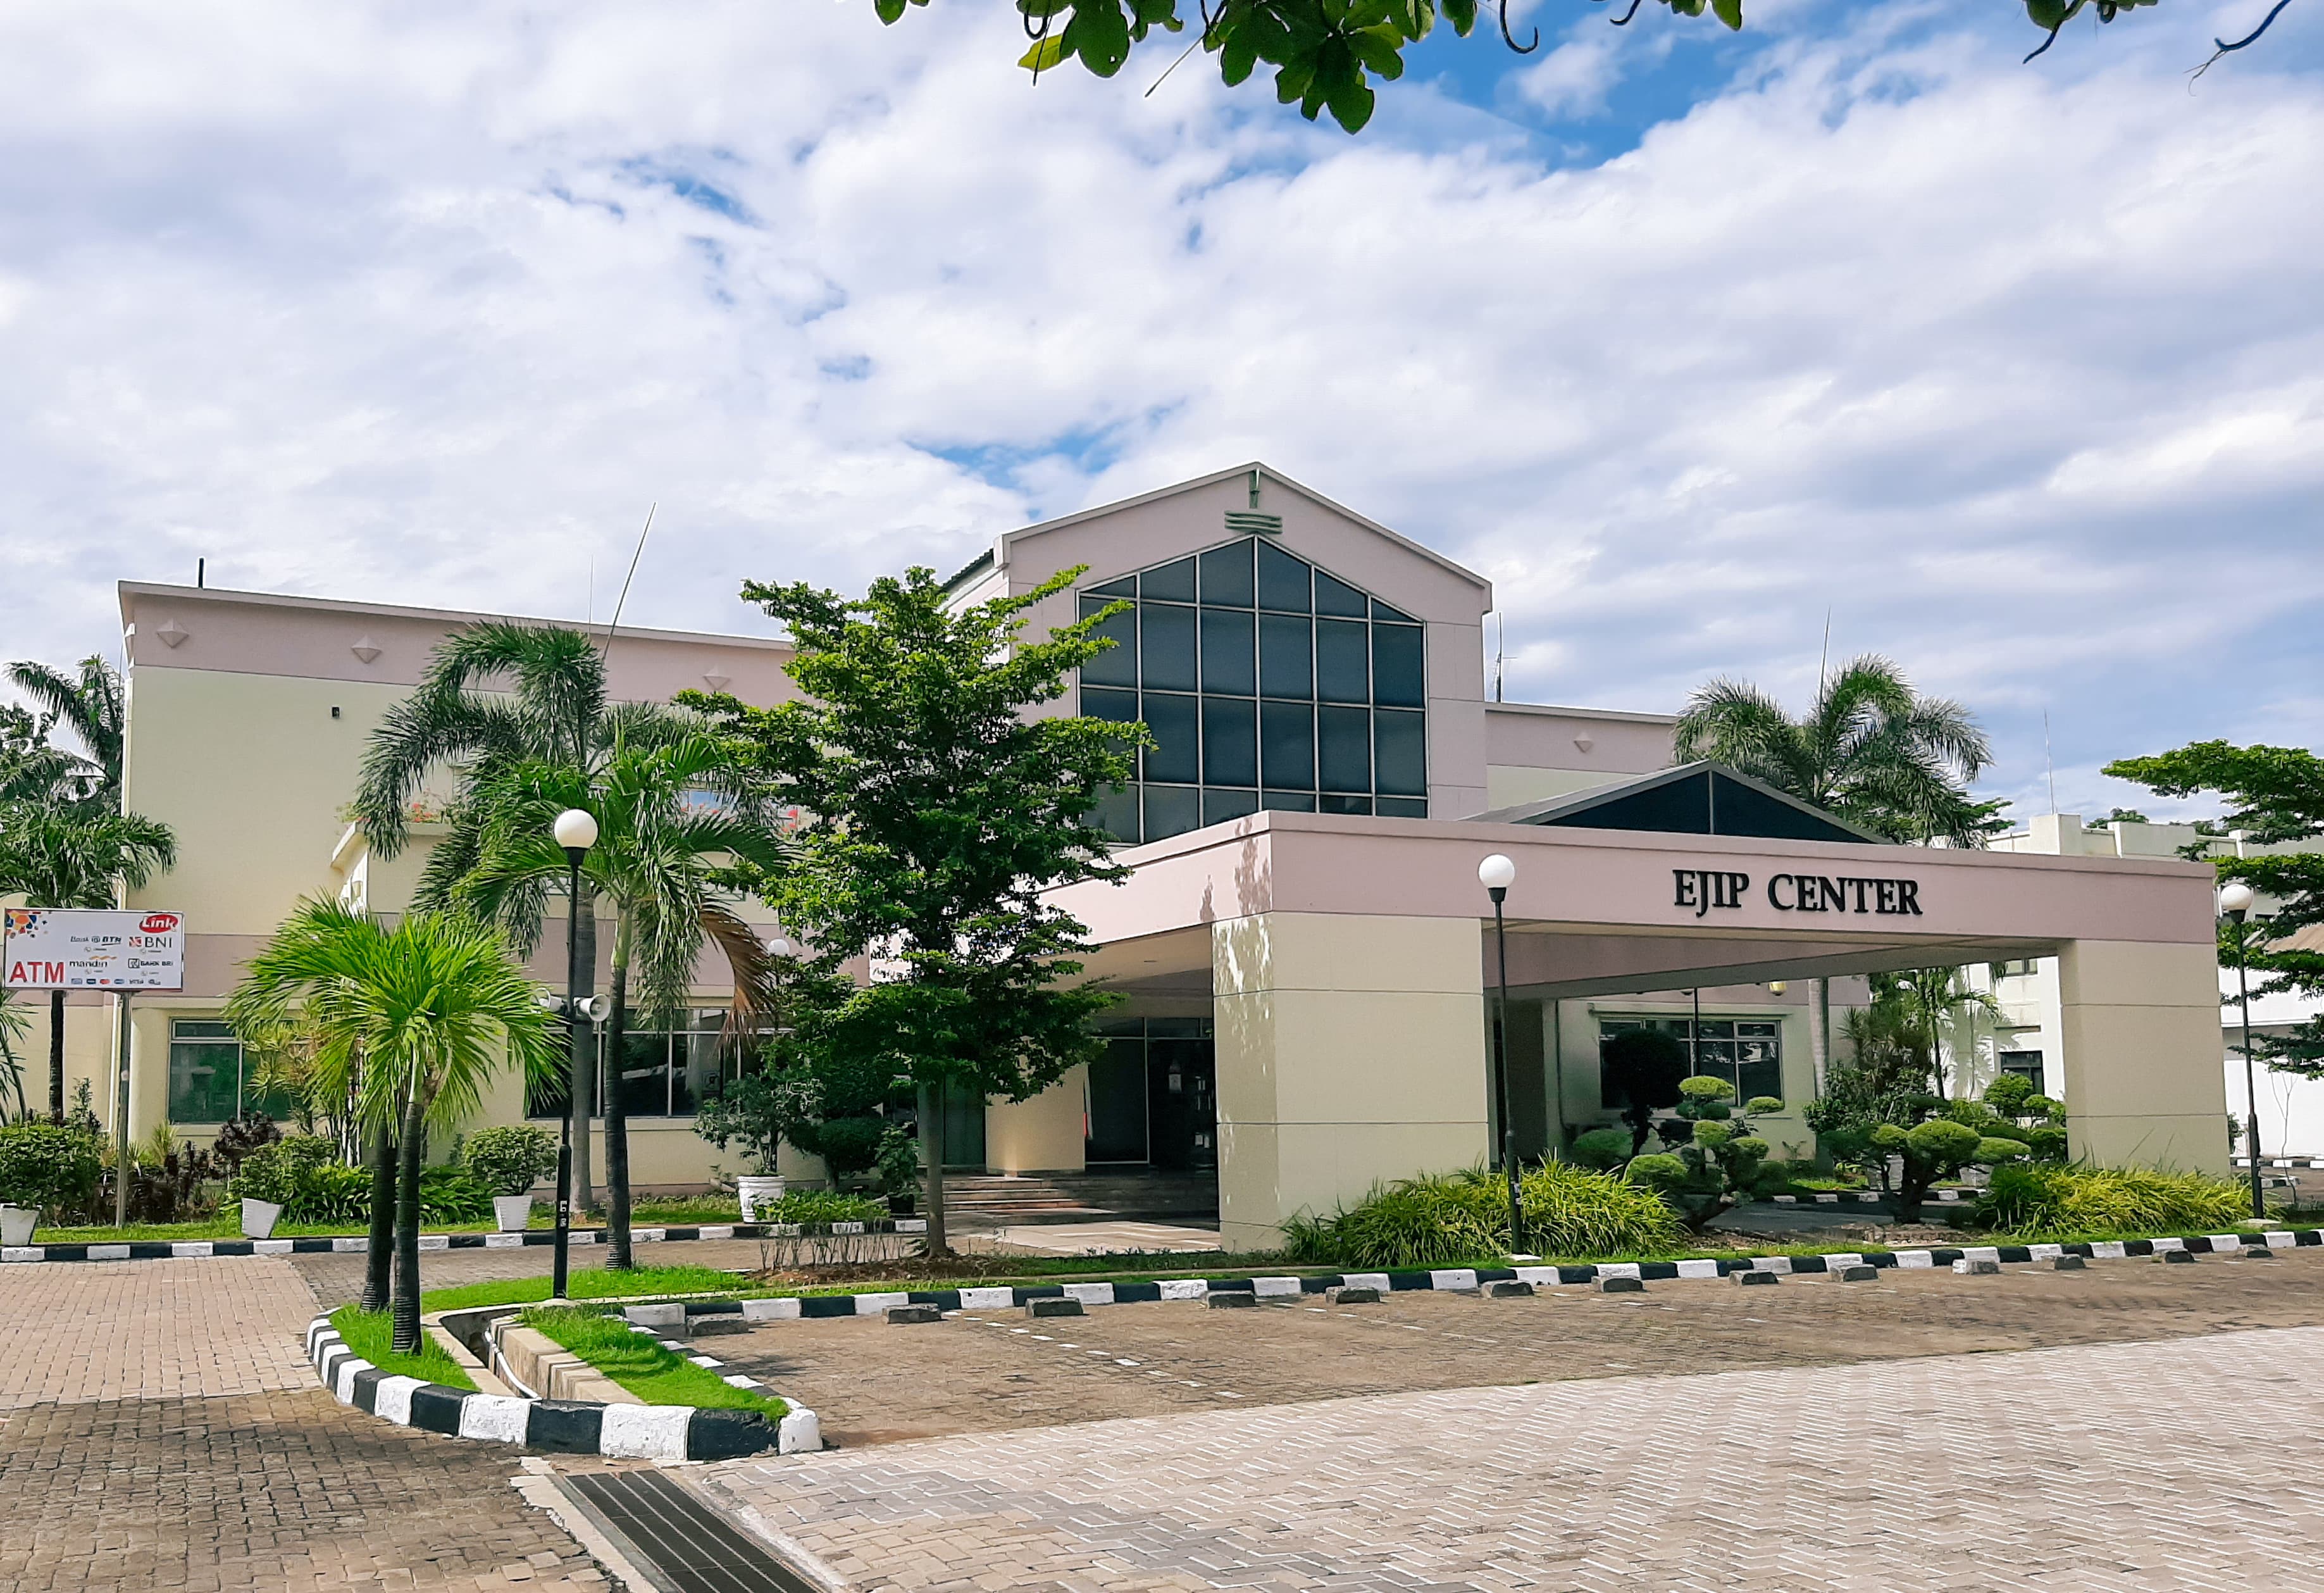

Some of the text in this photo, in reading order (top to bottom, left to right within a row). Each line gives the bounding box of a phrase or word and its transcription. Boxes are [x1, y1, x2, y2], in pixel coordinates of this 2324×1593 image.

[1672, 870, 1923, 917] EJIP CENTER
[142, 916, 175, 928] Link
[145, 937, 172, 948] BNI
[9, 961, 64, 984] ATM
